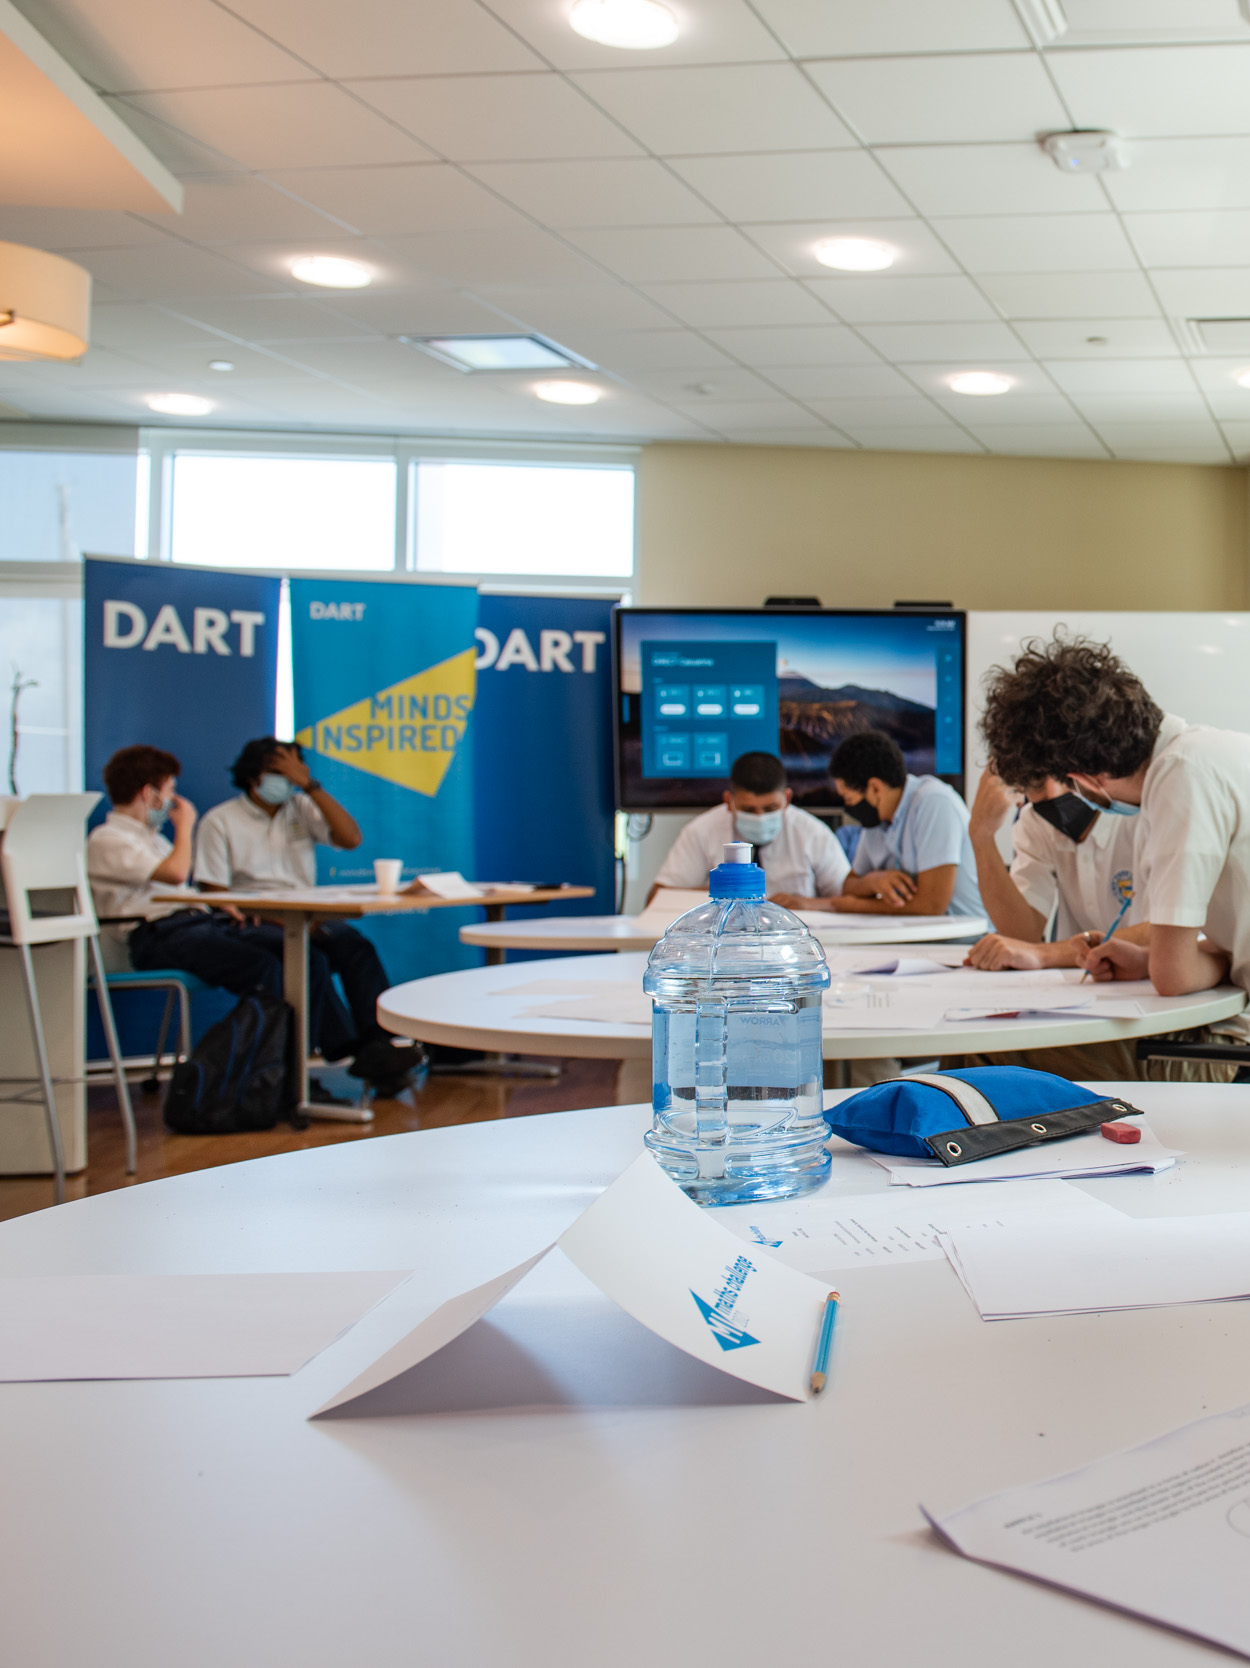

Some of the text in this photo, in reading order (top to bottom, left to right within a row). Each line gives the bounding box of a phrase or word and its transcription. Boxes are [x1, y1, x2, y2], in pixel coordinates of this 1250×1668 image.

[310, 600, 366, 621] DART
[103, 599, 265, 658] DART
[474, 627, 606, 673] DART
[370, 693, 469, 722] MINDS
[312, 723, 460, 752] INSPIRED
[721, 1255, 757, 1291] challenge
[713, 1287, 738, 1316] maths
